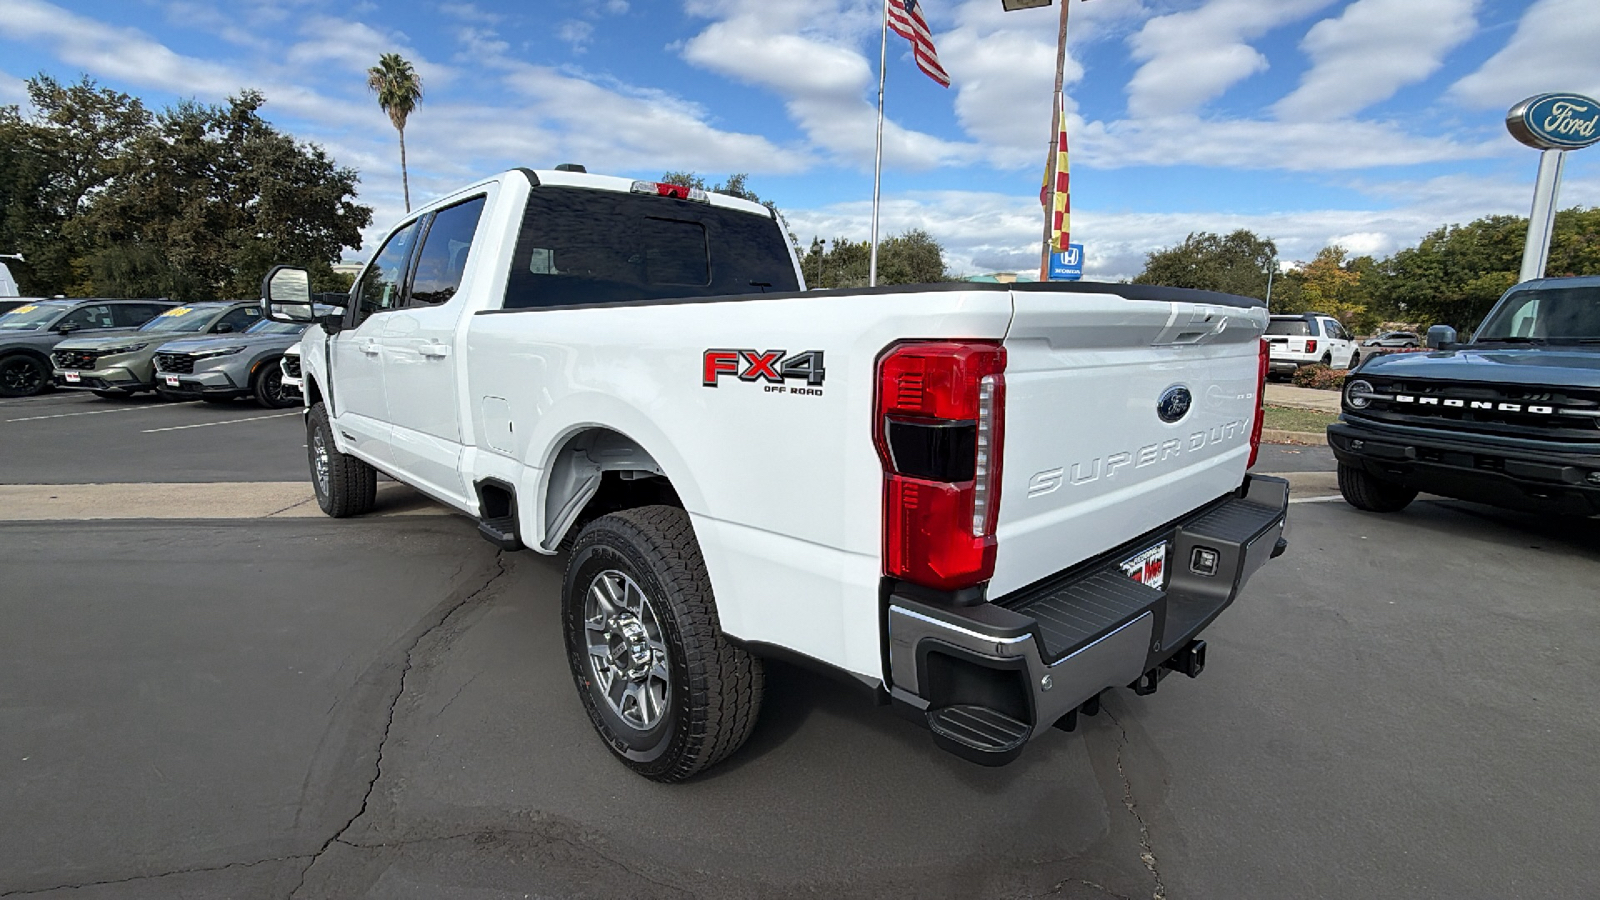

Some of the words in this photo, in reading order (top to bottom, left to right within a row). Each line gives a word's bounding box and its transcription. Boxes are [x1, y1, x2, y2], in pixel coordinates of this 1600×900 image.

[1544, 101, 1599, 137] Ford
[702, 348, 826, 388] FX4
[764, 385, 787, 393] OFF
[790, 387, 823, 396] ROAD
[1396, 395, 1553, 414] BRONCO
[1027, 437, 1182, 499] SUPER
[1188, 416, 1249, 453] DUTY
